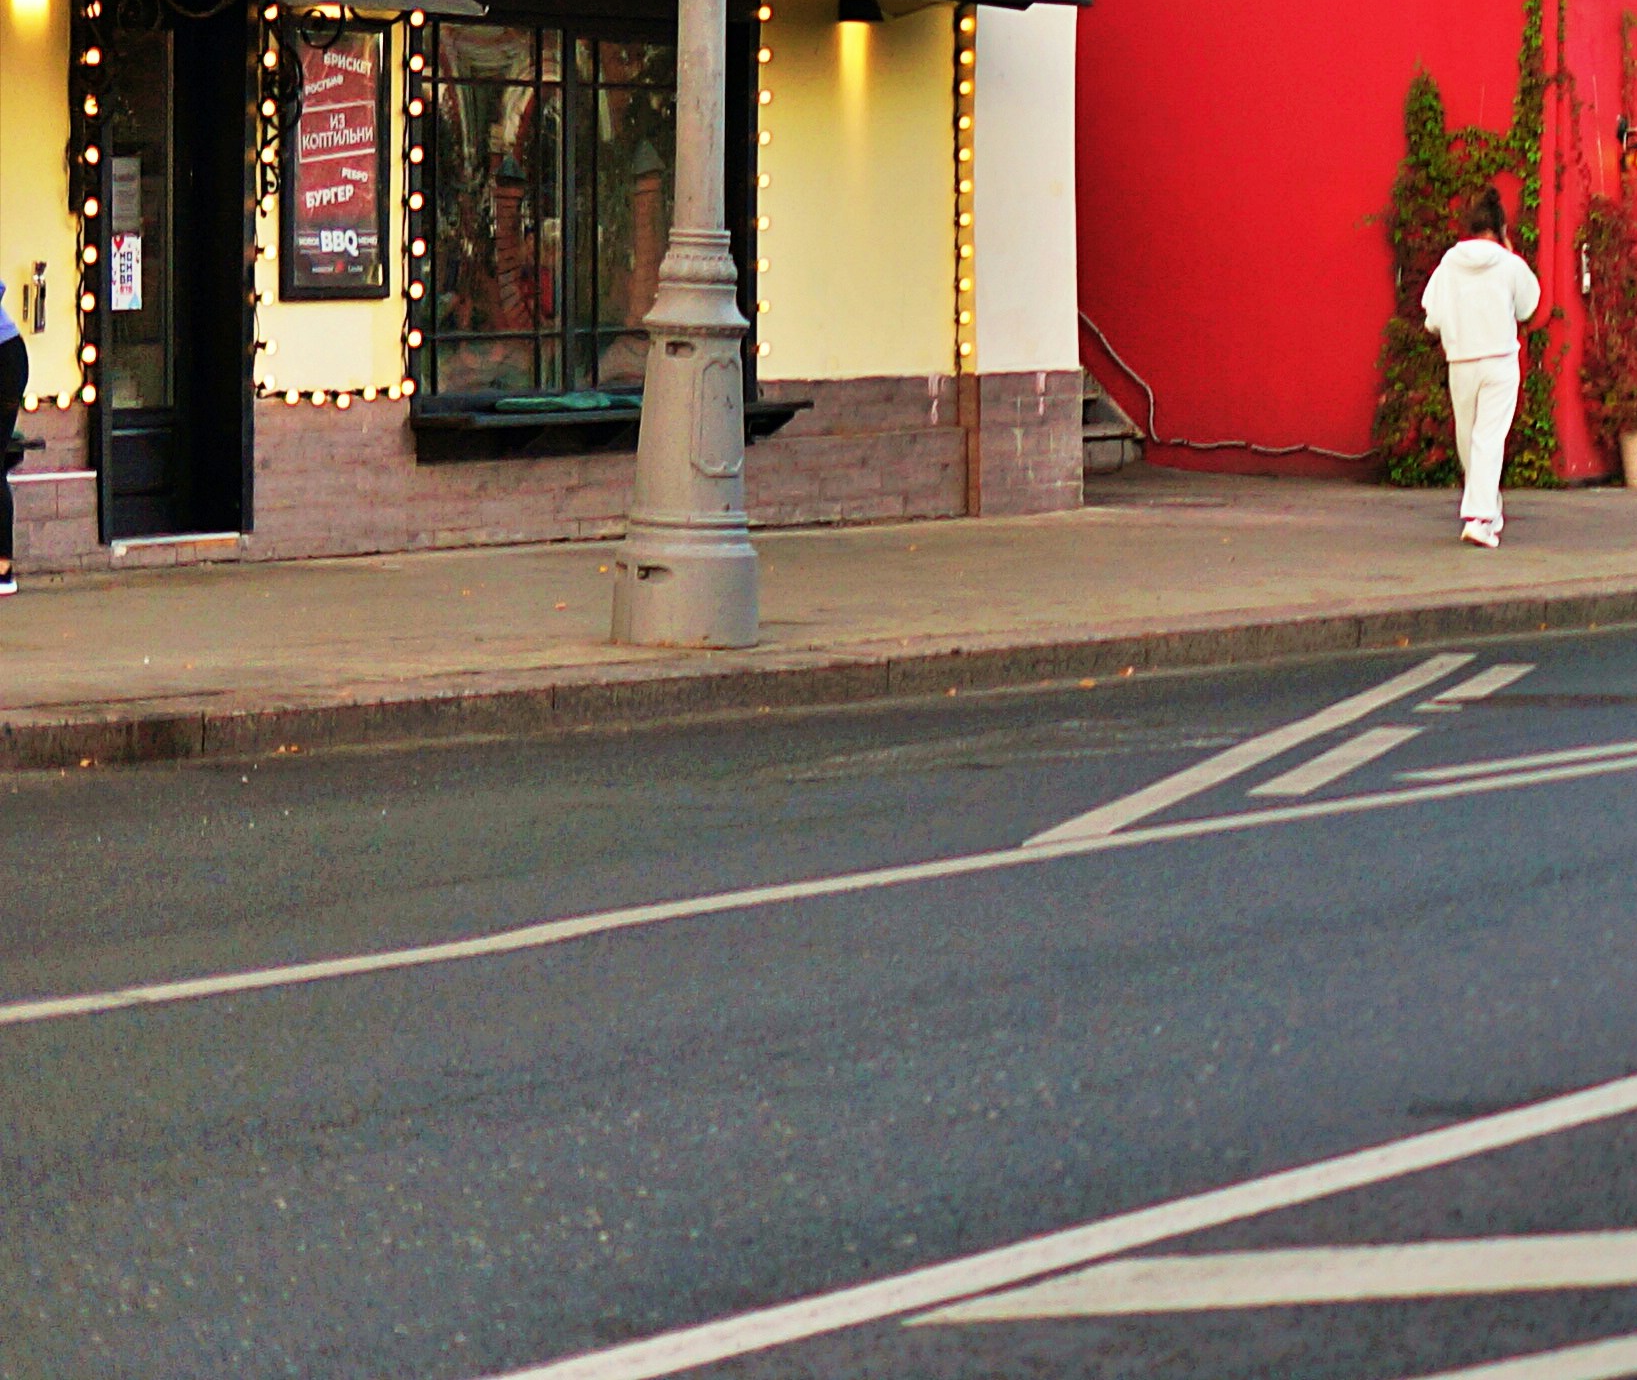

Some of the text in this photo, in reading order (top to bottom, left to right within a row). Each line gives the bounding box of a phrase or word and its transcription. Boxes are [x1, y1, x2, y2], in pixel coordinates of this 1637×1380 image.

[330, 112, 346, 131] ИЗ
[302, 126, 373, 151] КОПТИЛЬНИ
[305, 184, 354, 209] БУРГЕР
[320, 229, 359, 258] BBQ
